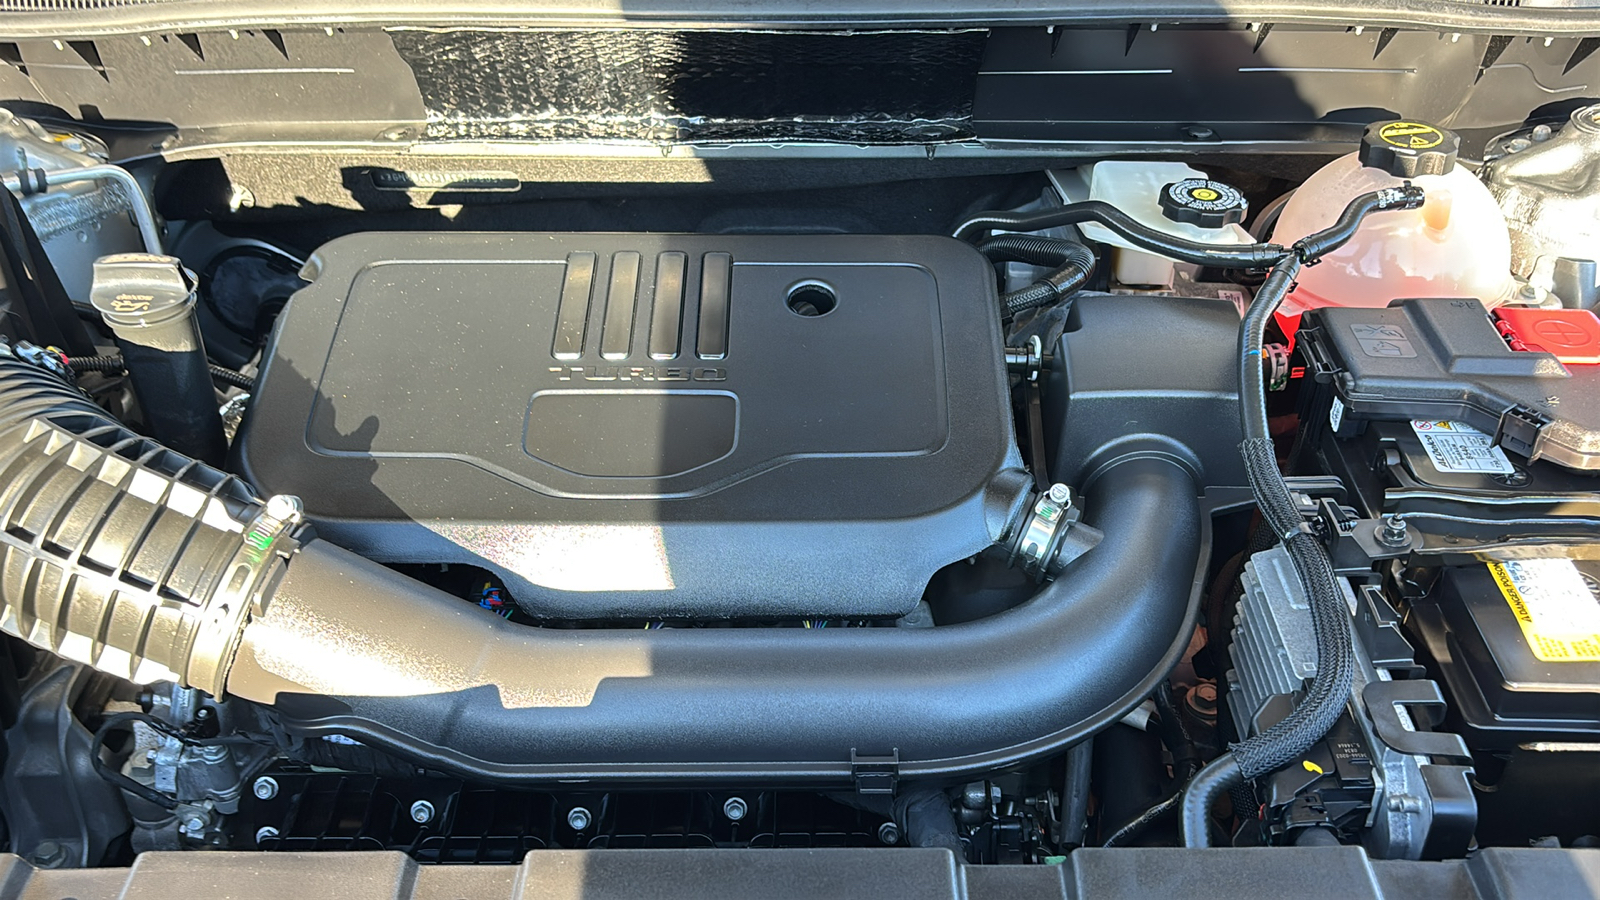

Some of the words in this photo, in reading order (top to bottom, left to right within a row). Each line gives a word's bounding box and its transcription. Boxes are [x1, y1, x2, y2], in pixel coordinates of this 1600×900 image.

[548, 366, 728, 381] TURBO
[1424, 434, 1448, 468] ACDelco
[1506, 587, 1528, 615] DANGER
